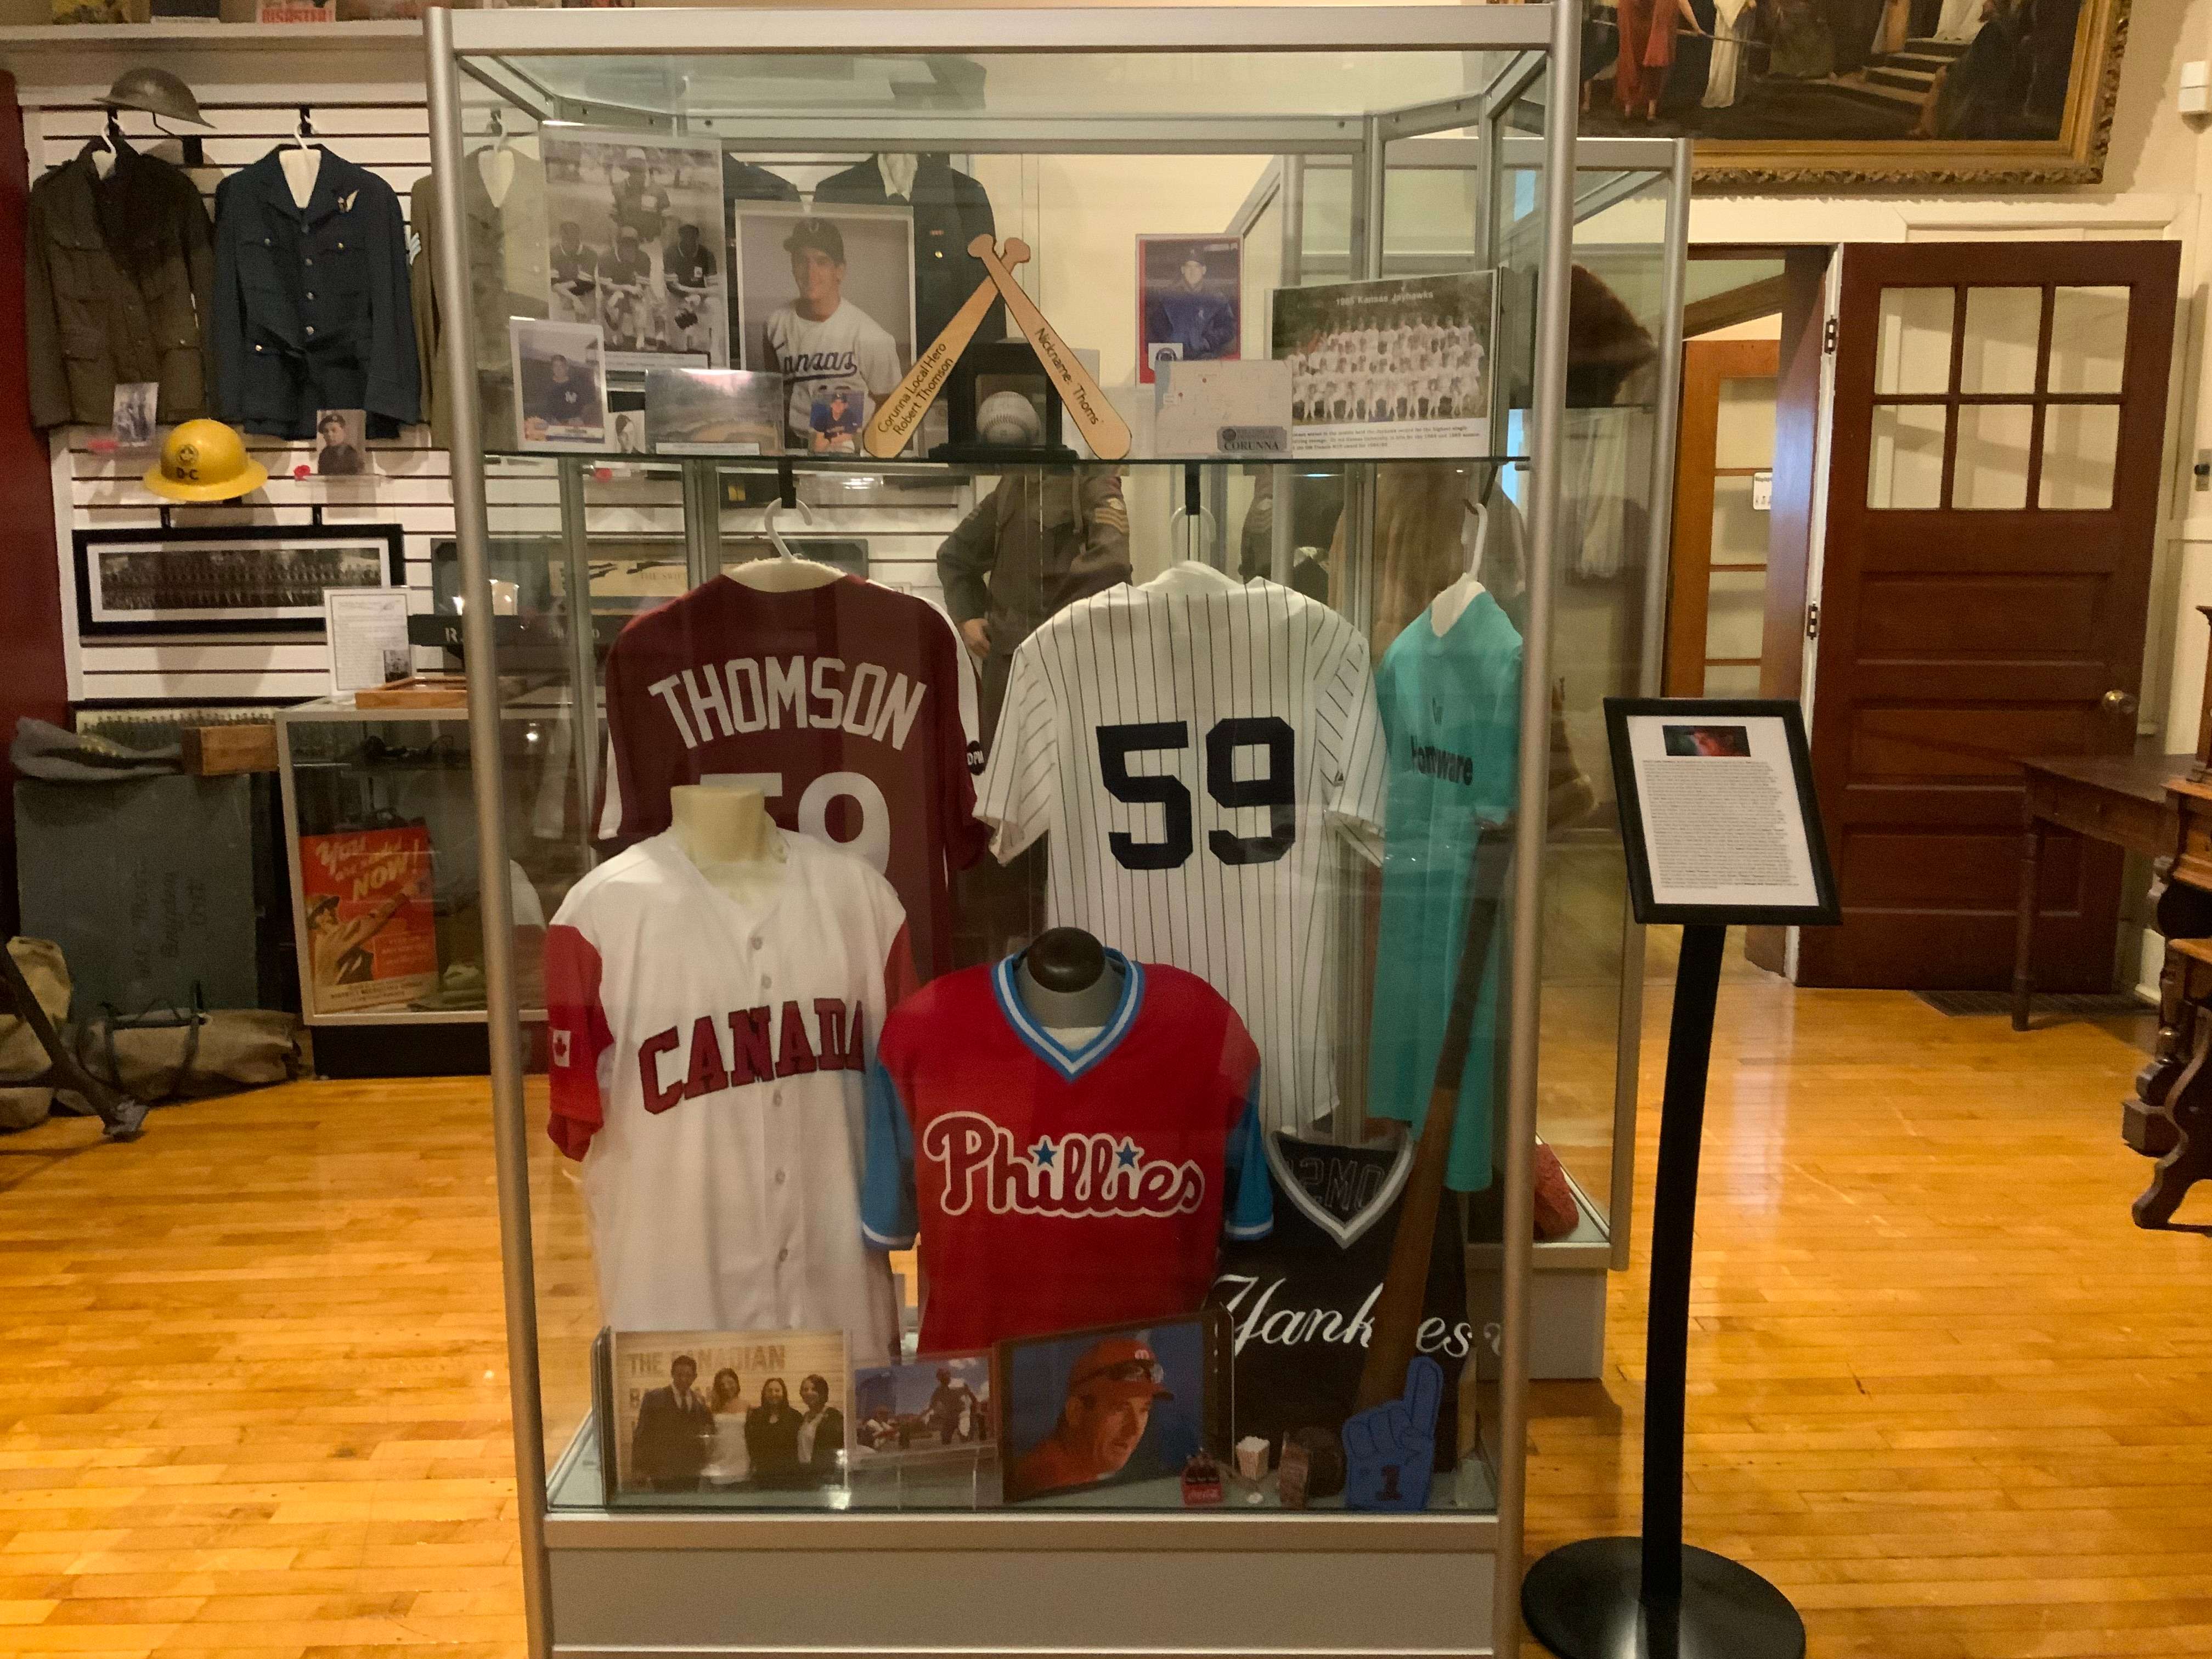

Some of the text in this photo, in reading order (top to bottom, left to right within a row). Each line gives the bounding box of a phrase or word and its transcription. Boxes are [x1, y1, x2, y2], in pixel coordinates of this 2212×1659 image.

[1392, 291, 1434, 304] Jayhawks
[783, 351, 857, 375] ansas
[878, 343, 947, 432] Corunna Local Hero
[893, 358, 953, 435] Robert Thomson
[1224, 441, 1279, 450] CORUNNA
[647, 655, 927, 751] THOMSON
[1096, 716, 1295, 870] 59
[923, 1111, 1205, 1218] Phillies
[1208, 1274, 1473, 1358] Yankes
[627, 1352, 663, 1376] THE
